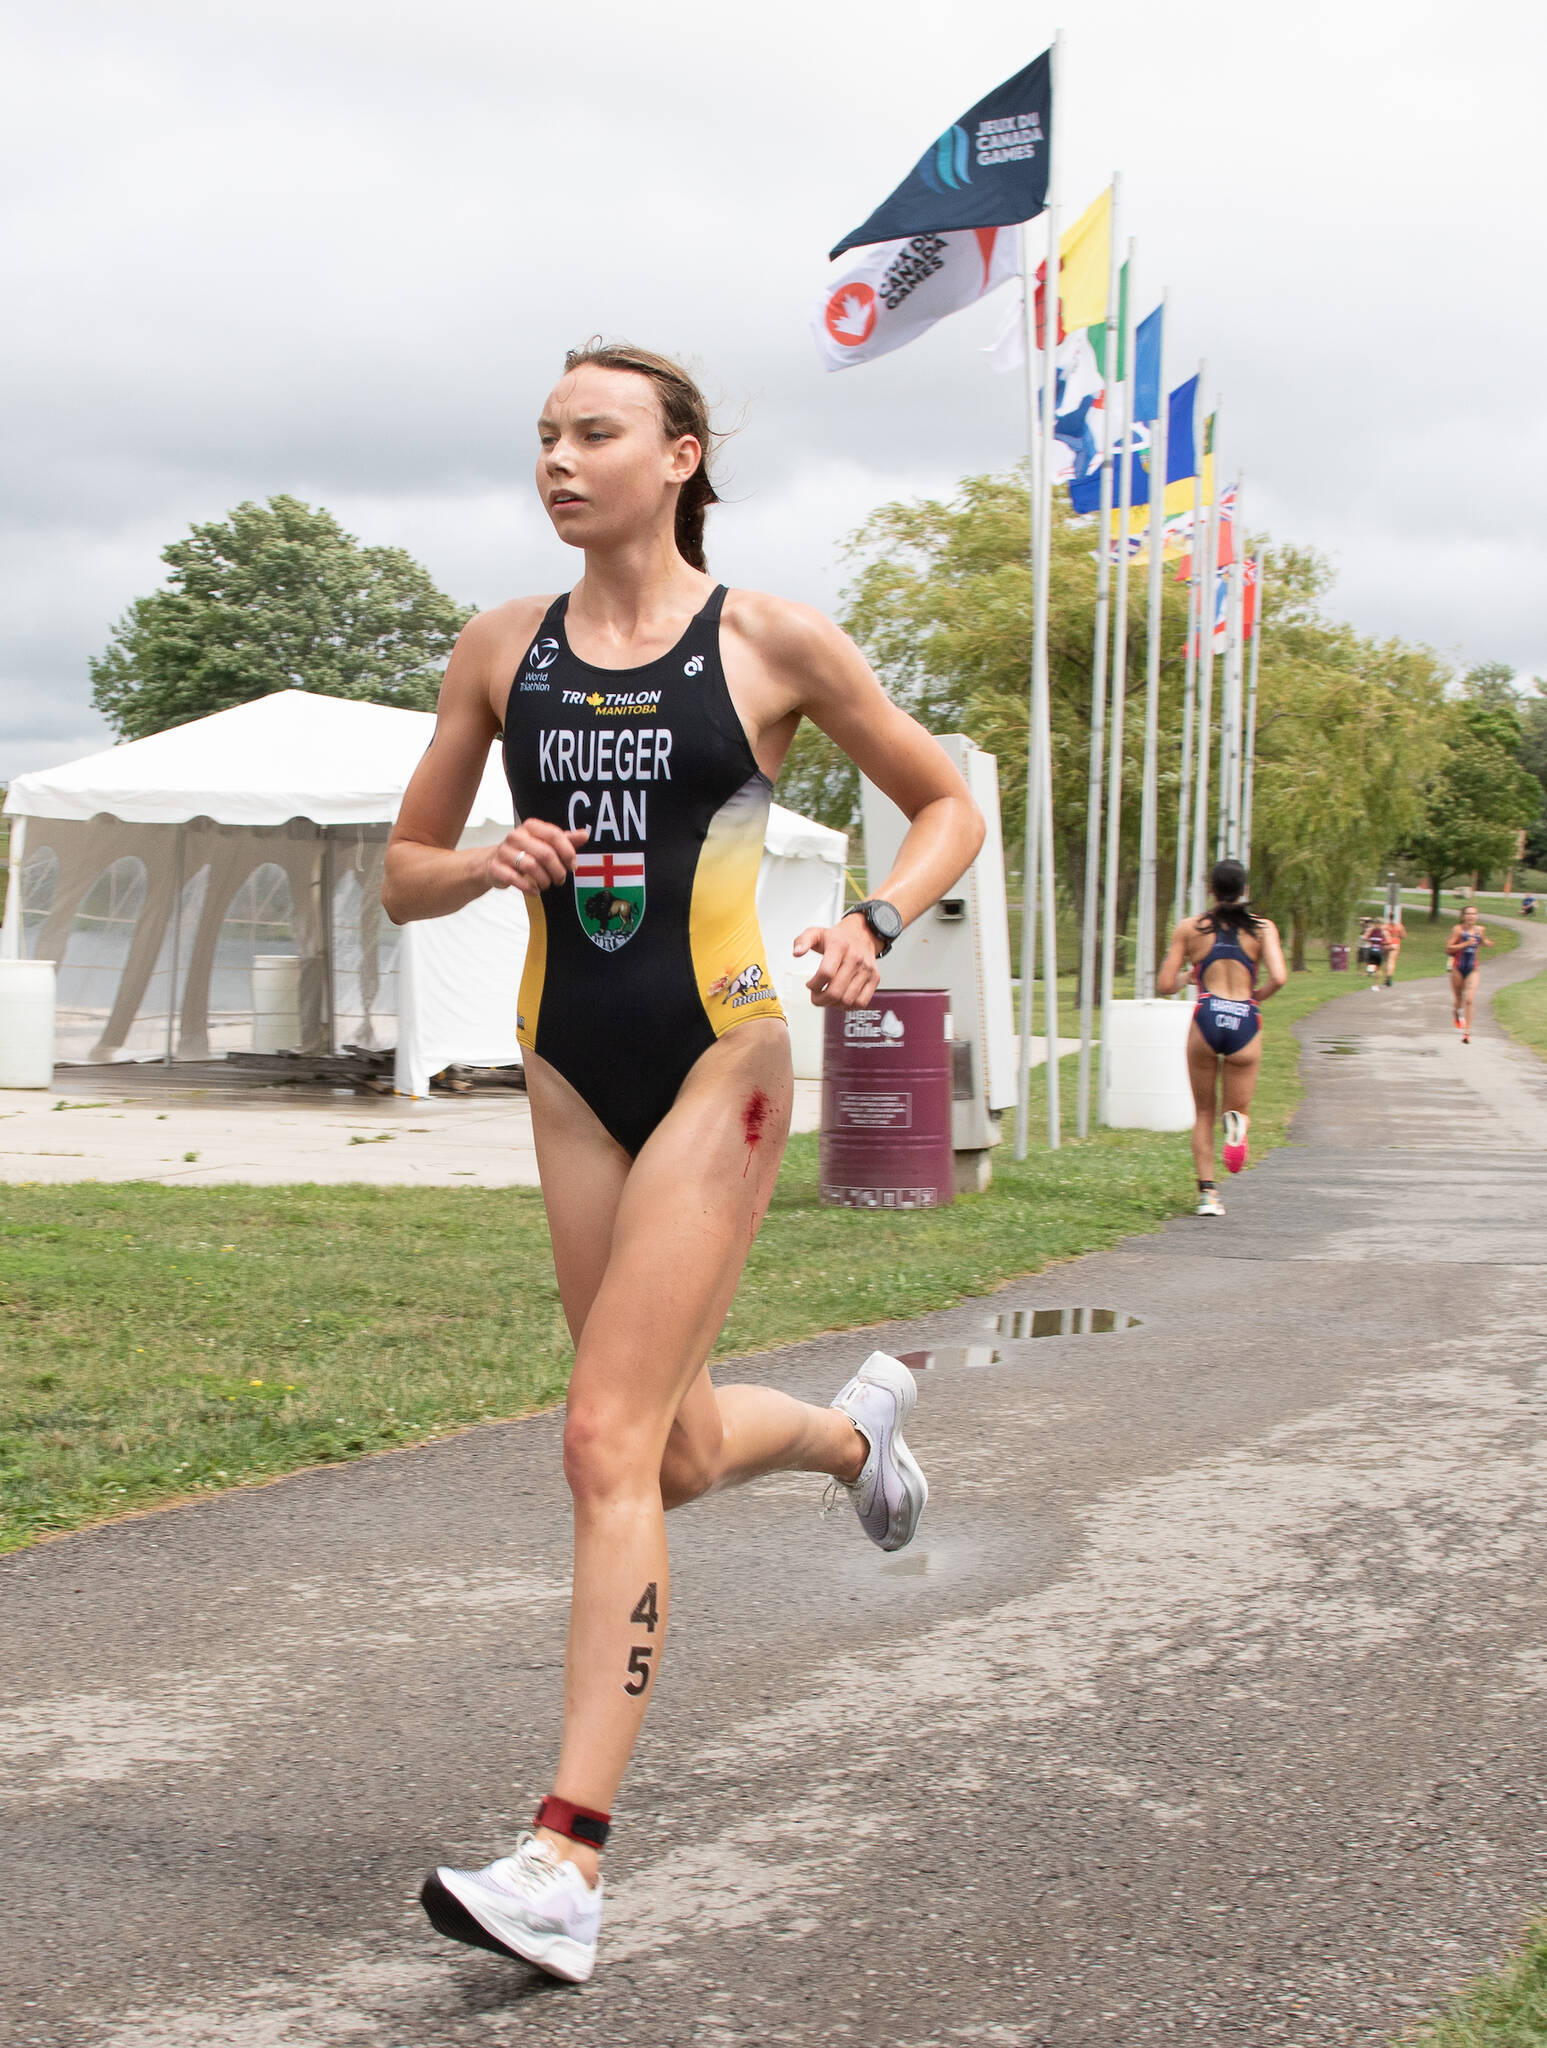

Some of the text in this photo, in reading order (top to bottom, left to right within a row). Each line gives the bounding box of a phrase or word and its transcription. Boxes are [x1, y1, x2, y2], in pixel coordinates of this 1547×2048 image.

[1017, 112, 1040, 130] DU
[976, 127, 1044, 151] CANADA
[976, 144, 1035, 166] GAMES
[879, 238, 948, 298] CANADA
[887, 256, 944, 309] GAMES
[519, 682, 550, 692] Triathlon
[525, 672, 548, 681] World
[595, 705, 657, 716] MANITOBA
[539, 729, 673, 782] KRUEGER
[568, 790, 647, 842] CAN
